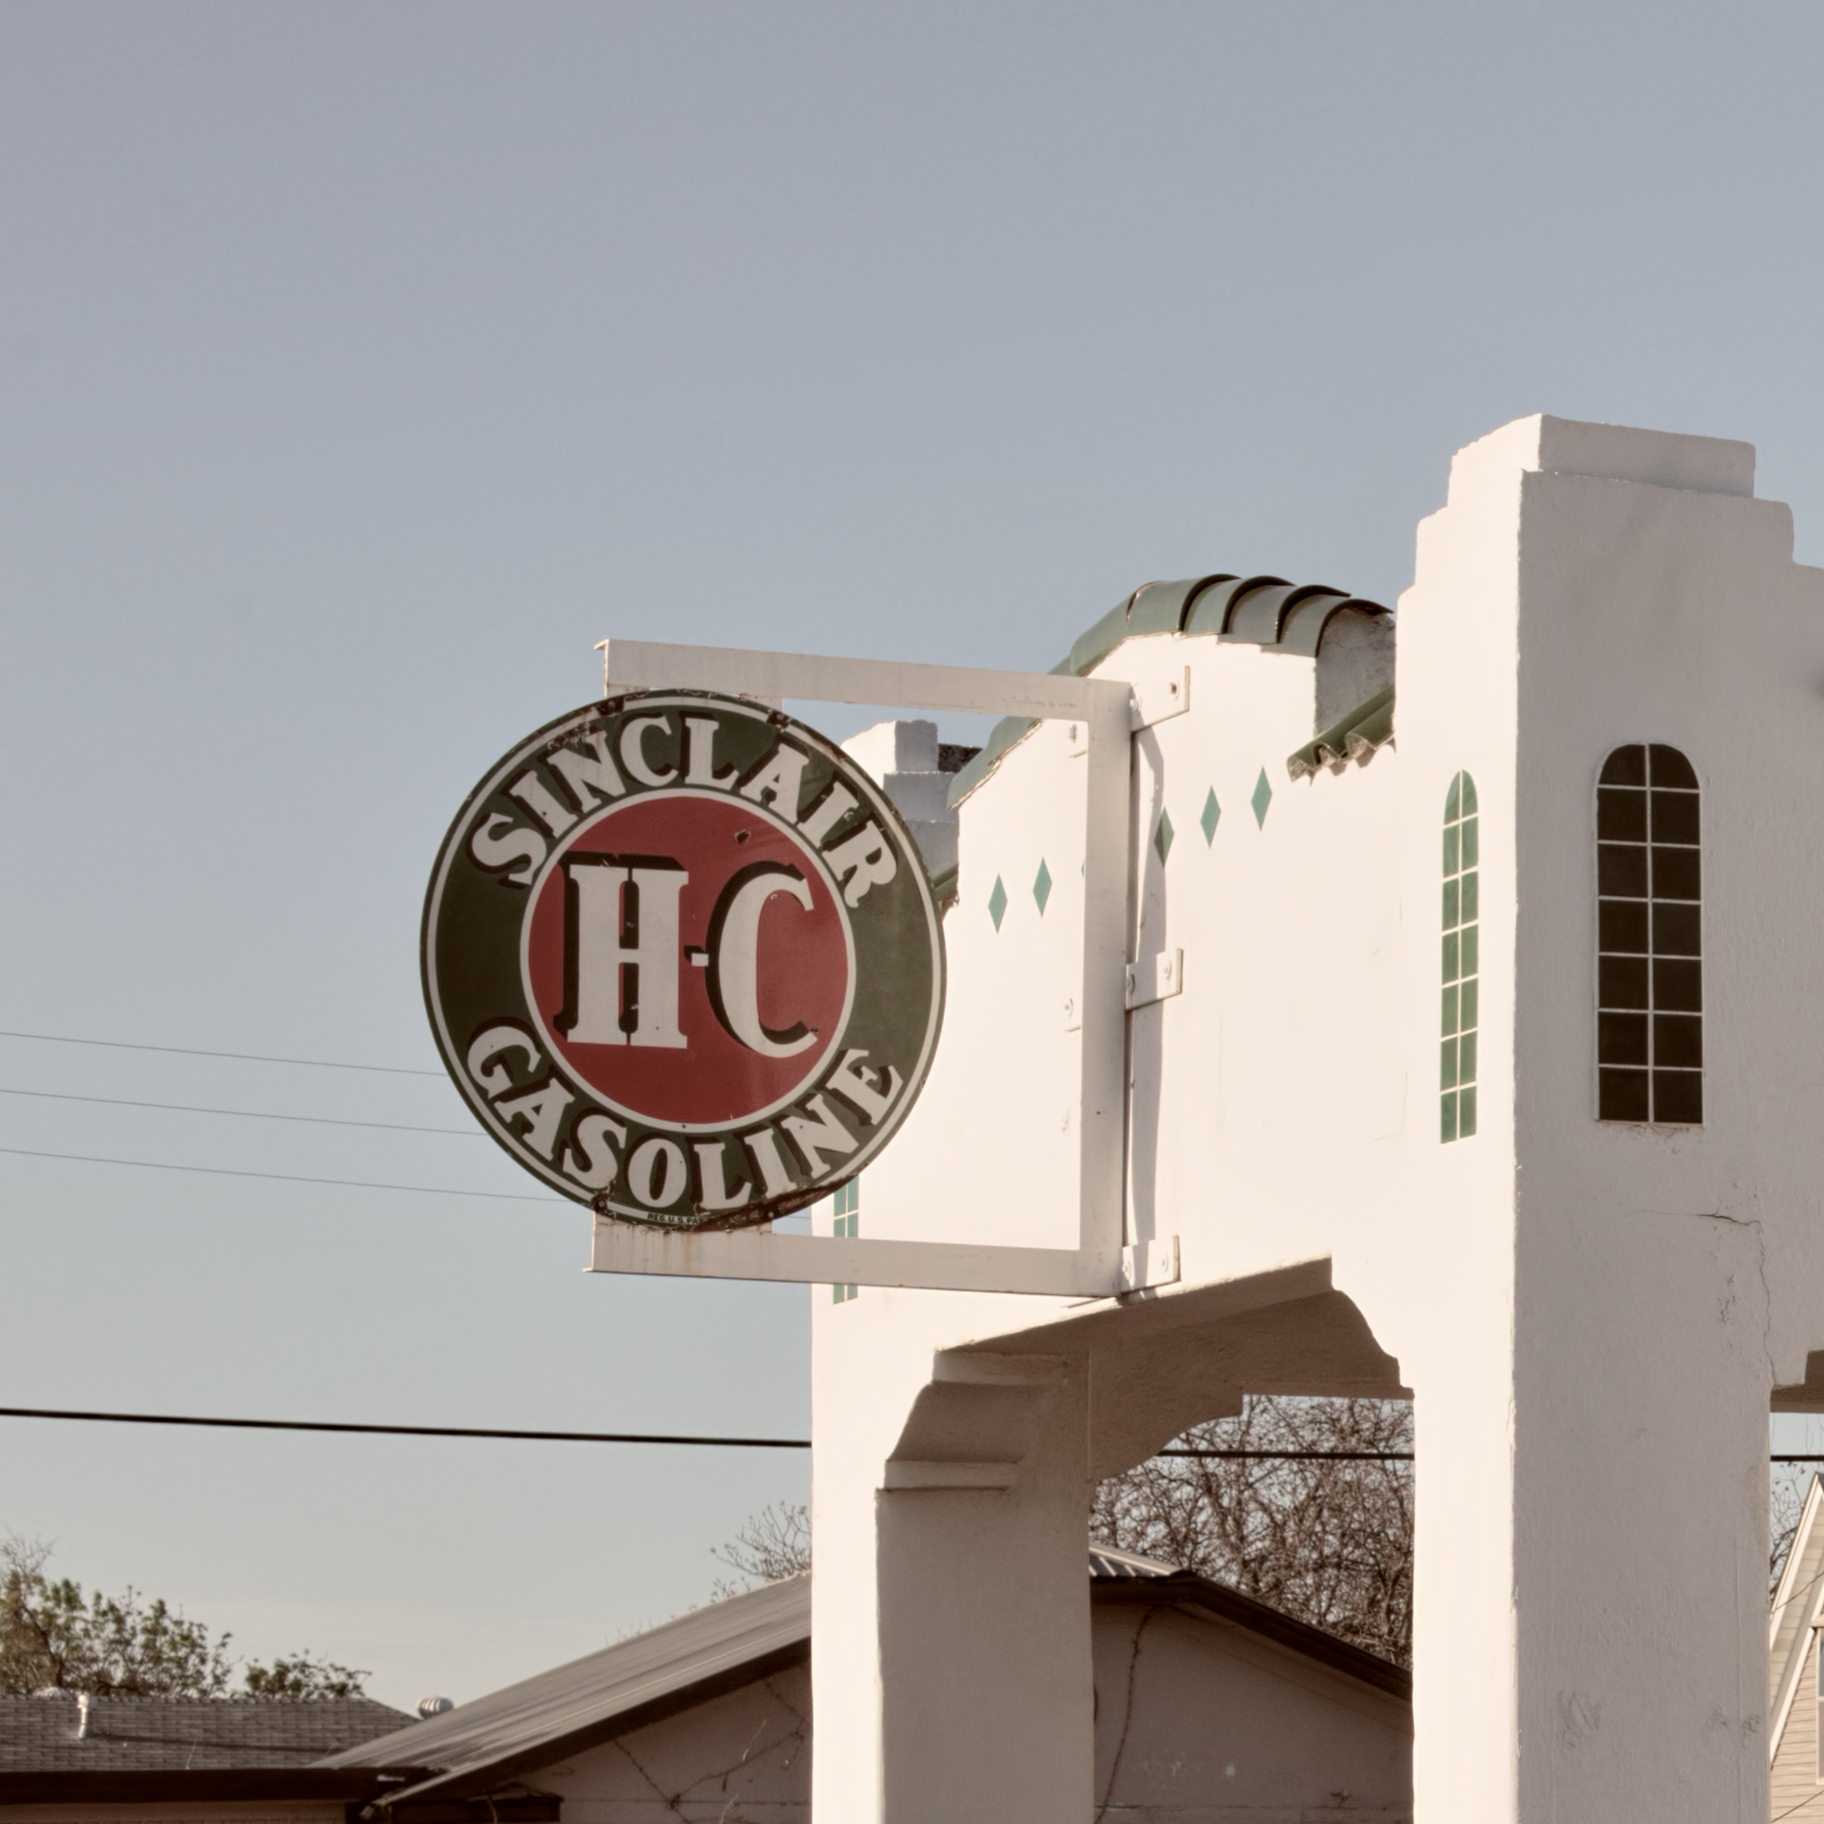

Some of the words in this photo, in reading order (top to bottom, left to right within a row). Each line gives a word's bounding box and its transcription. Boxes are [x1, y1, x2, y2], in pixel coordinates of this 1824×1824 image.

[471, 714, 898, 908] SINCLAIR
[562, 860, 818, 1059] H-C
[466, 1025, 904, 1211] GASOLINE
